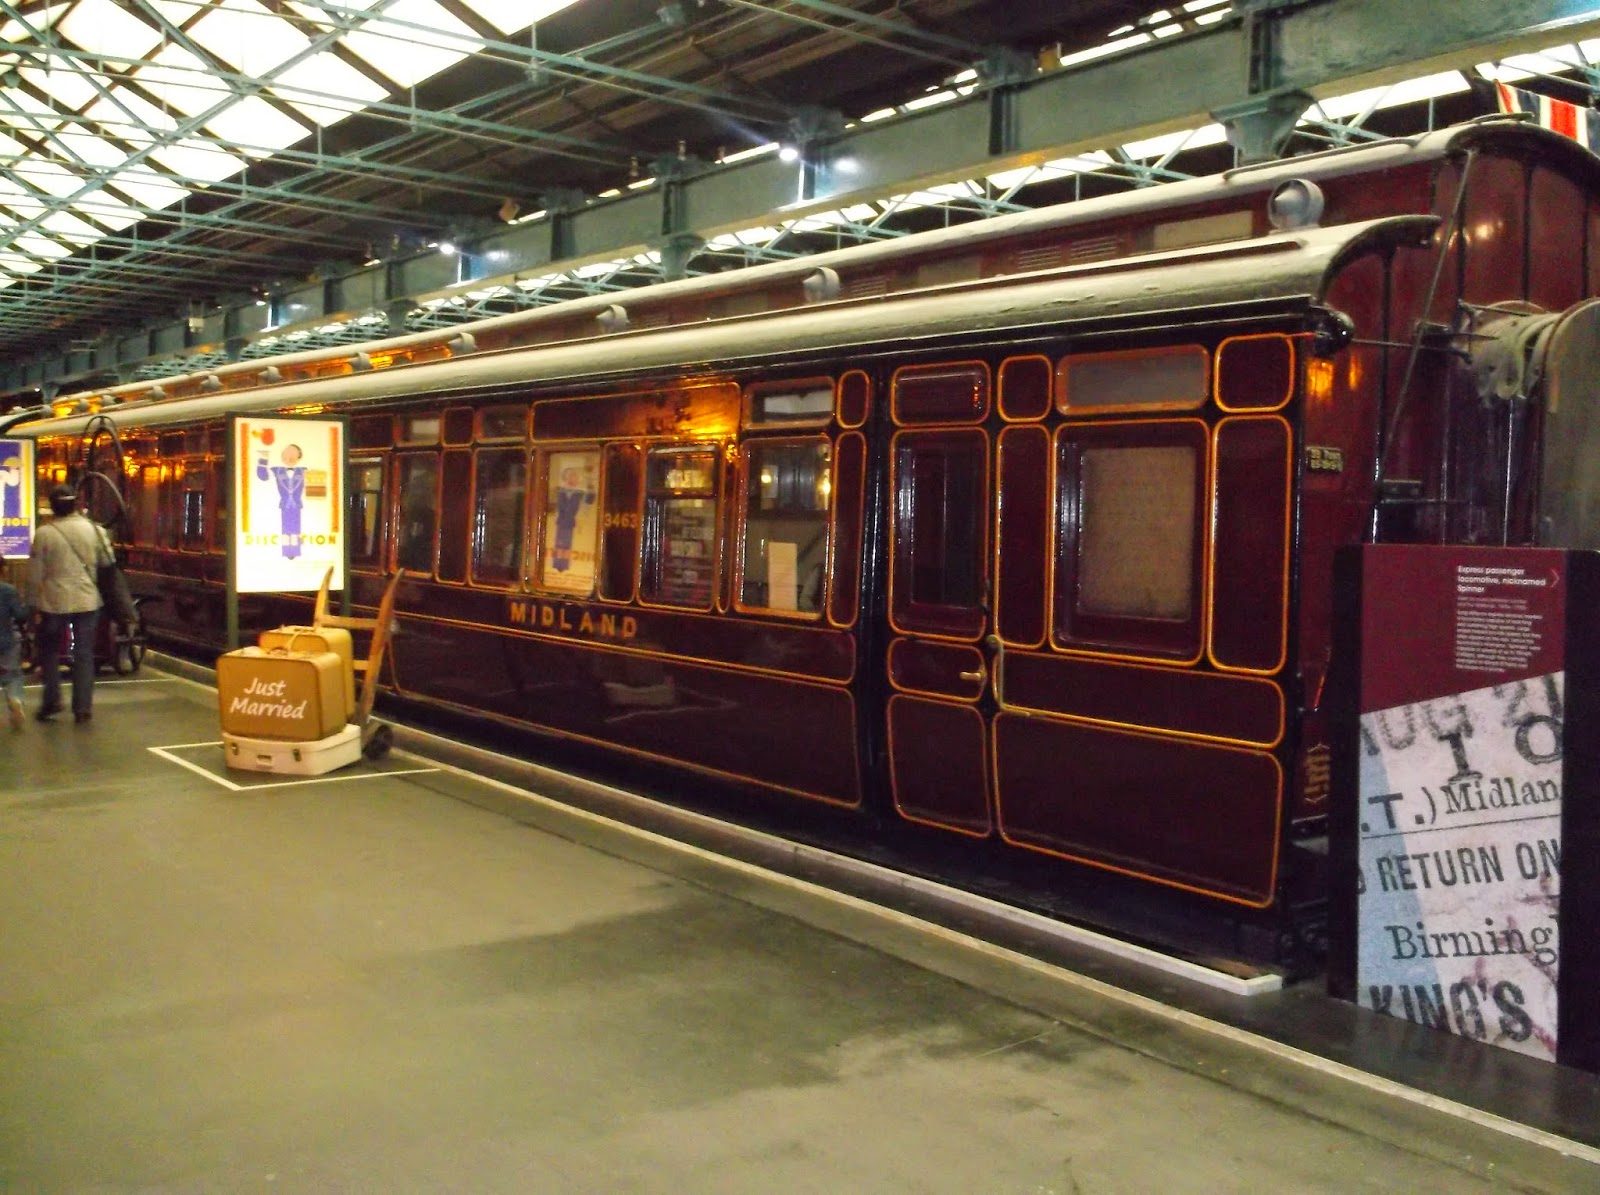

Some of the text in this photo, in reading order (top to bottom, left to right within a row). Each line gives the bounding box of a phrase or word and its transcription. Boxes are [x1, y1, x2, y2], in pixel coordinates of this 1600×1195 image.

[1457, 565, 1526, 577] Express passenger
[1502, 577, 1547, 587] nicknamed
[1457, 585, 1485, 593] Spinner
[510, 602, 638, 639] MIDLAND
[244, 677, 287, 697] Just
[229, 696, 308, 720] Married
[1441, 776, 1563, 816] Midlan
[1376, 845, 1505, 893] RETURN
[1383, 916, 1559, 967] Birming
[1367, 979, 1534, 1043] KING'S
